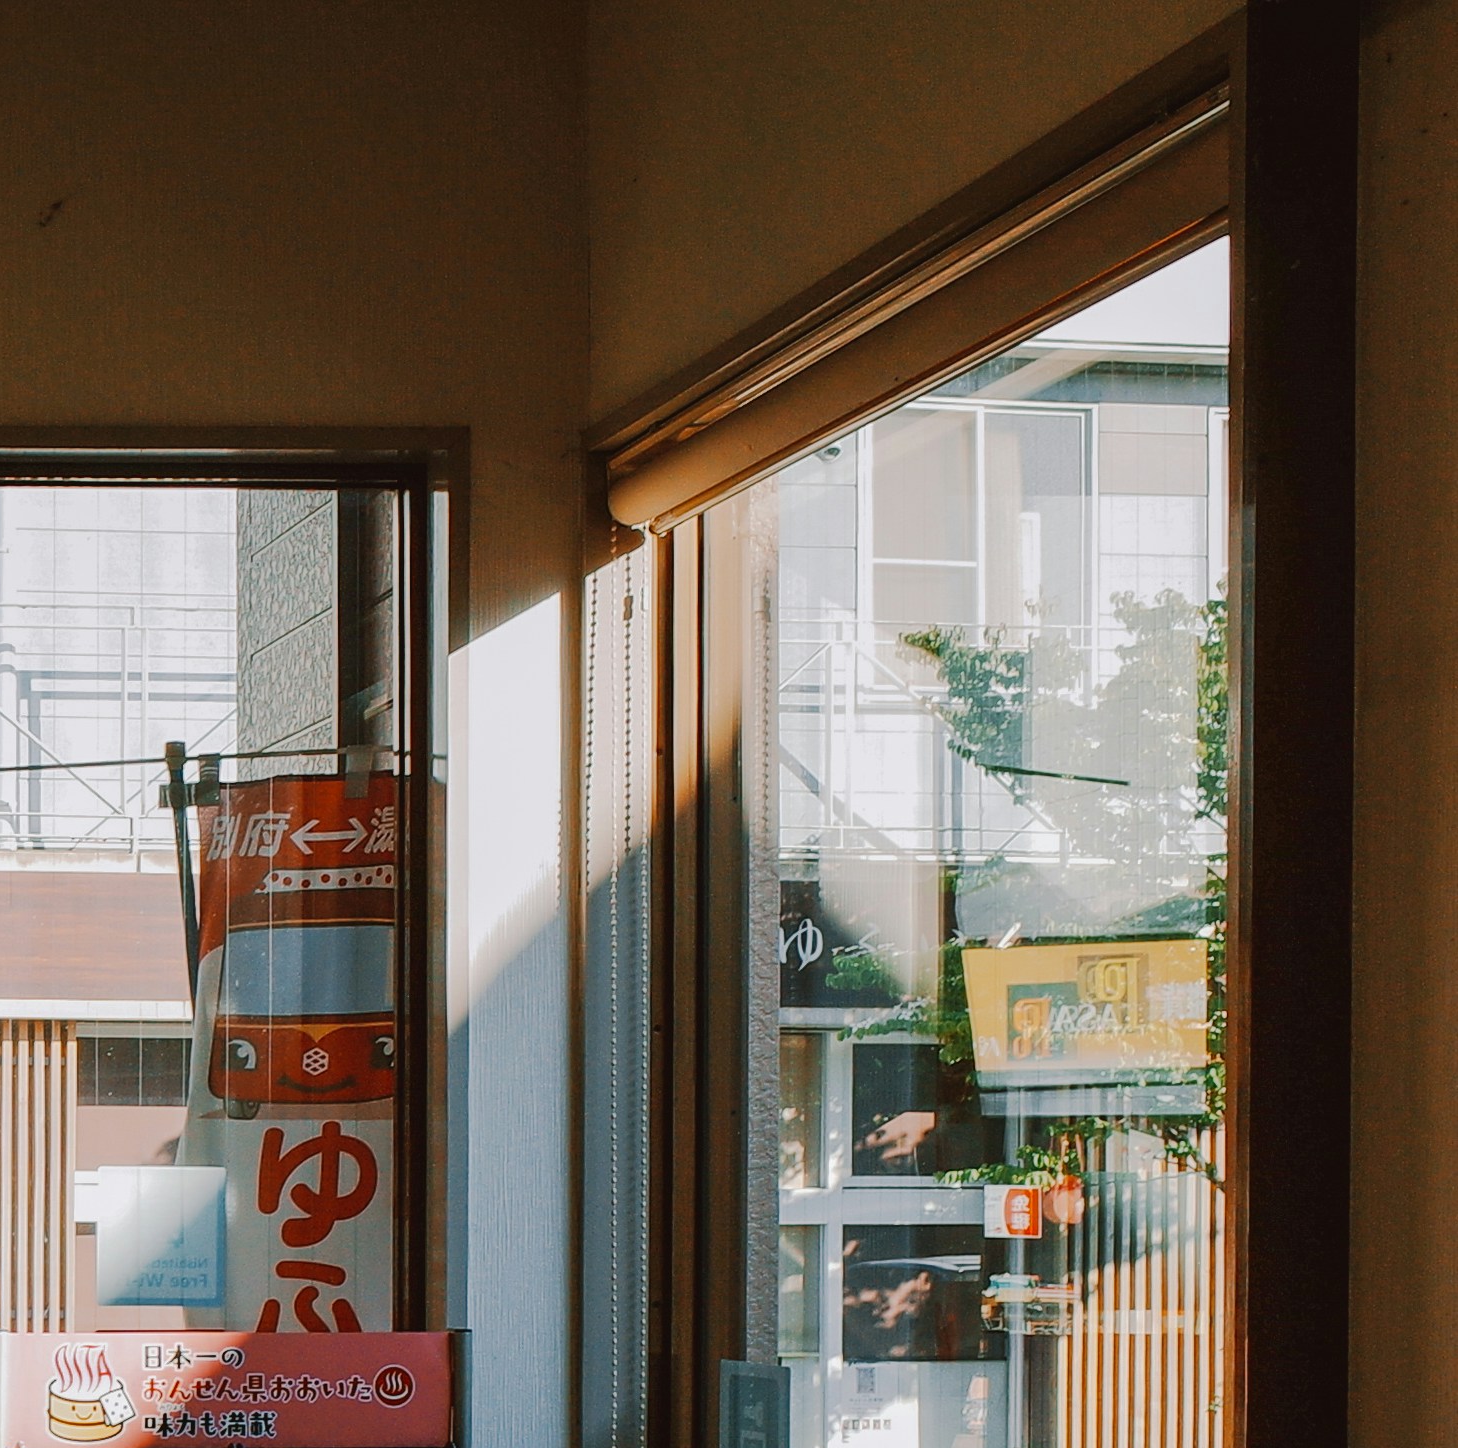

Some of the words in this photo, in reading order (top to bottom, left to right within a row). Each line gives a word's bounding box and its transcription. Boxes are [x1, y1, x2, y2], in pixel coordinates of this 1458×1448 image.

[205, 809, 292, 861] 別府
[143, 1345, 244, 1370] 日本一の
[142, 1373, 374, 1403] おんせん県おおいた
[143, 1410, 278, 1438] 味力も満載
